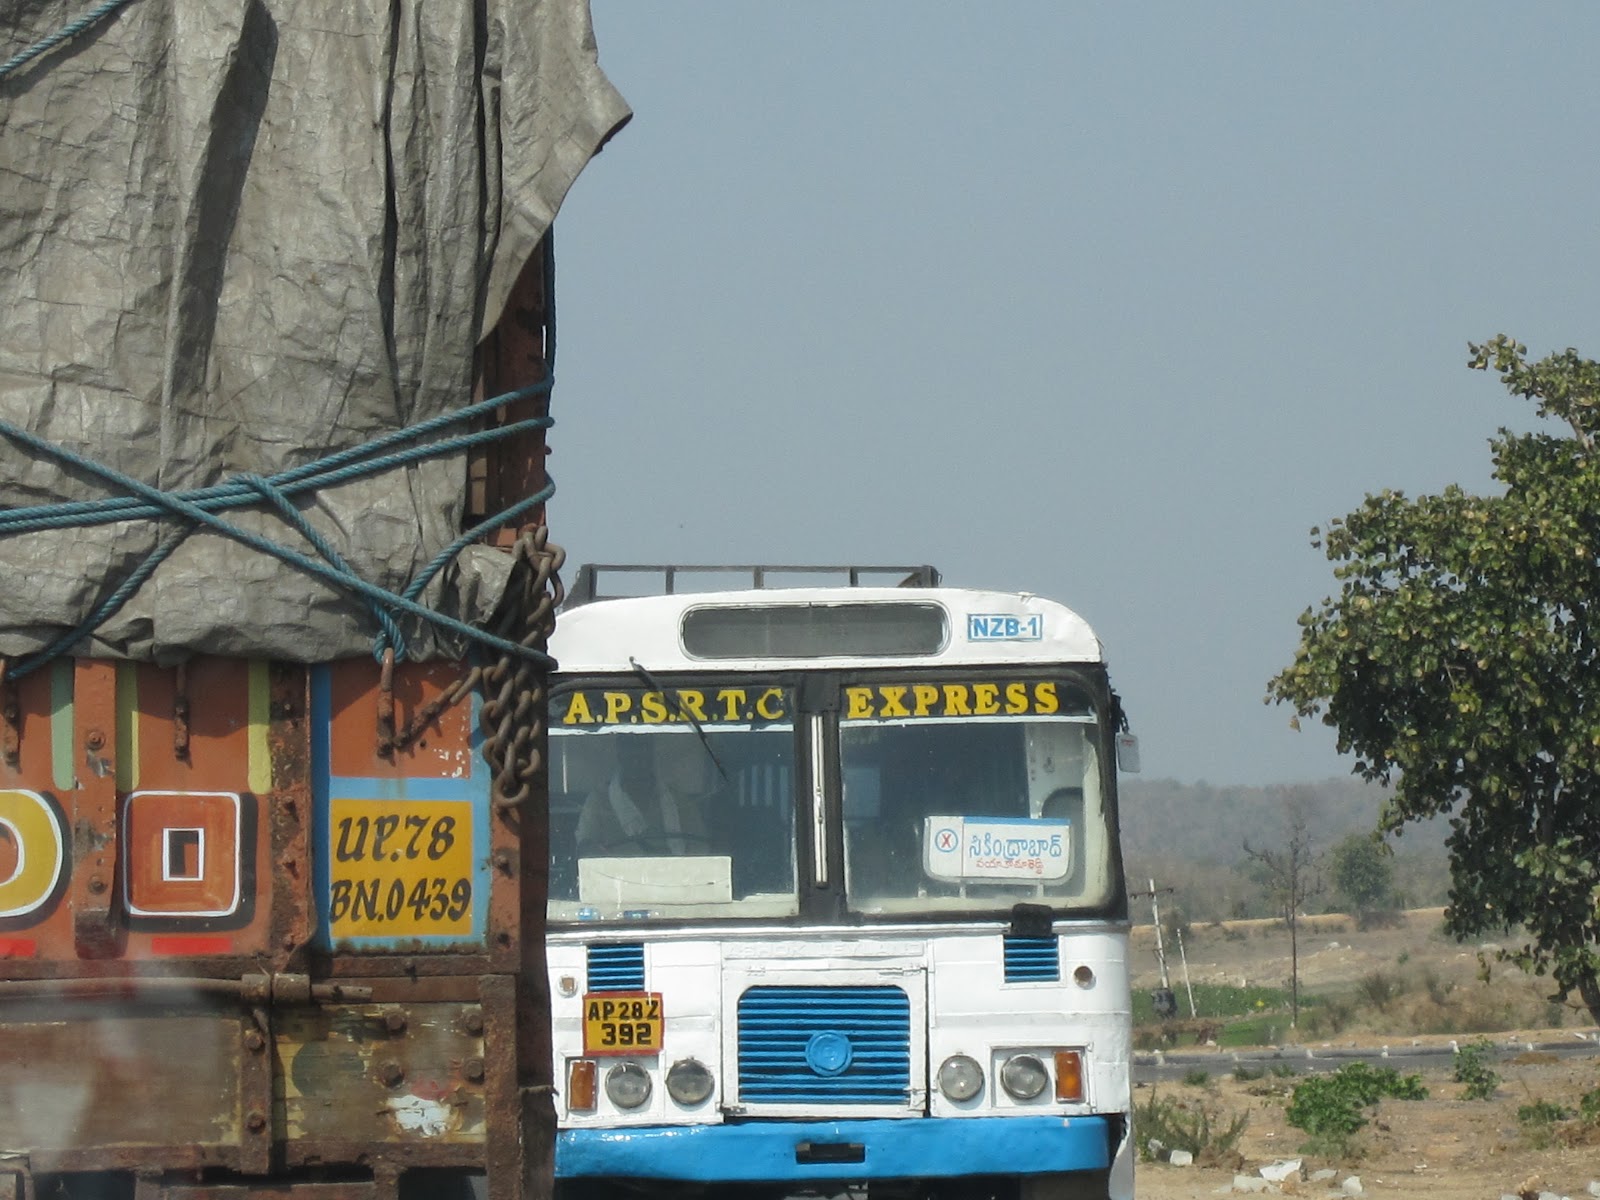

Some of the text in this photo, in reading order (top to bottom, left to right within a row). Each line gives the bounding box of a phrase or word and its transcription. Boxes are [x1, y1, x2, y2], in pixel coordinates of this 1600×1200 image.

[973, 616, 1038, 638] NZB-1
[845, 681, 1061, 720] EXPRESS
[336, 813, 457, 863] UP.78
[328, 877, 473, 924] BN.0439
[601, 1022, 652, 1046] 392
